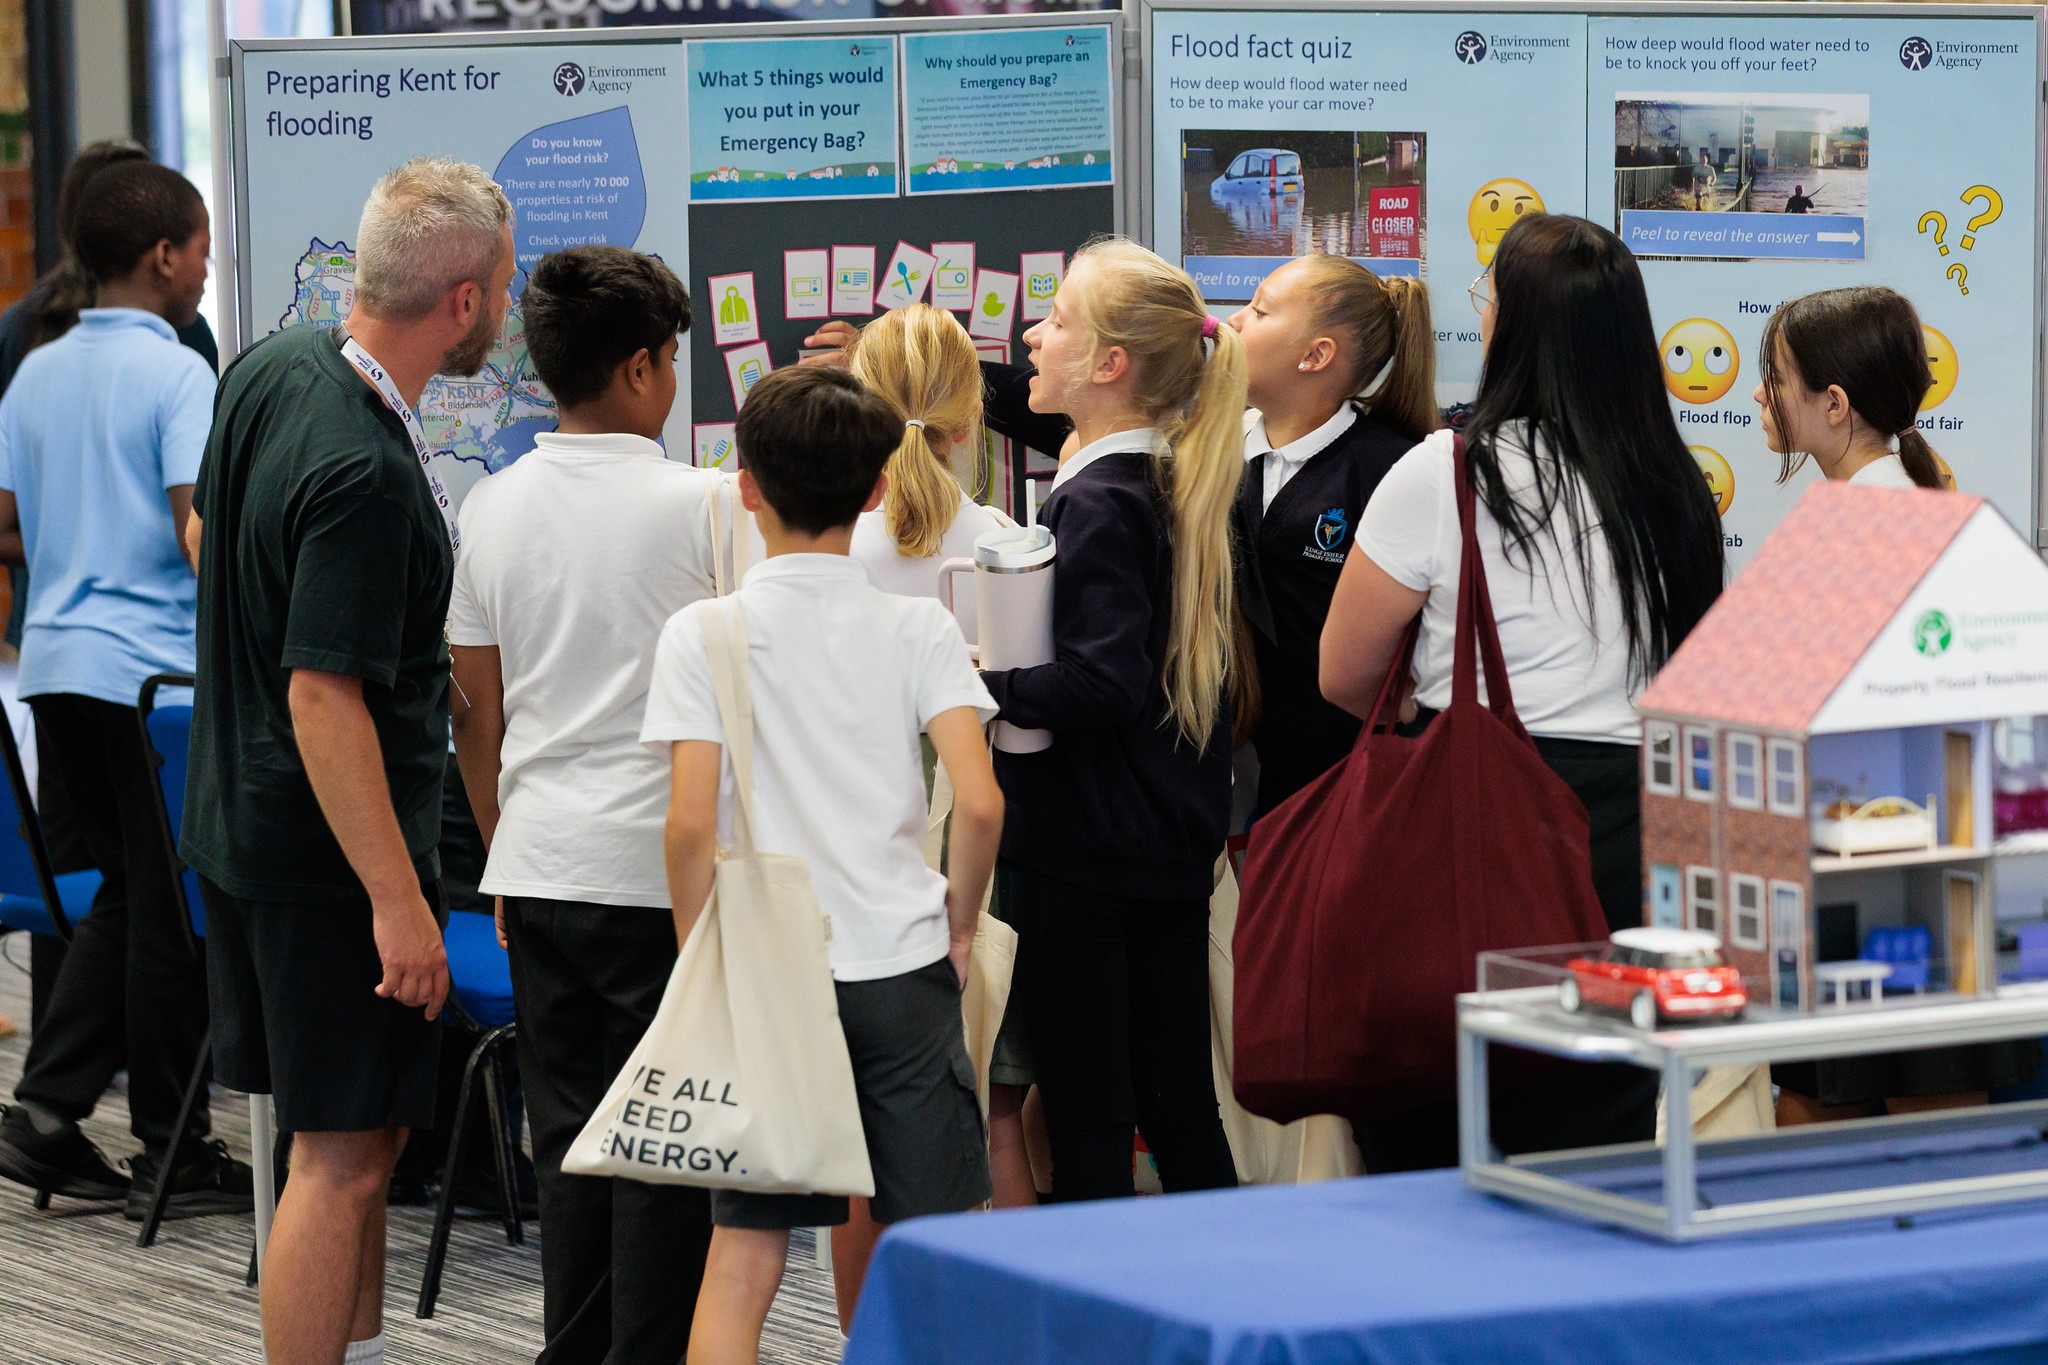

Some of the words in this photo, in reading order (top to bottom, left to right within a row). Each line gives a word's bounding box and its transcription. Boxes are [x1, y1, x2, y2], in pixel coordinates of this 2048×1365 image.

[1171, 34, 1239, 58] Flood
[1247, 34, 1294, 58] fact
[1301, 36, 1353, 64] quiz
[1490, 35, 1571, 48] Environment
[1604, 36, 1638, 51] How
[1641, 37, 1675, 54] deep
[1679, 37, 1724, 52] would
[1728, 38, 1765, 52] flood
[1770, 39, 1810, 53] water
[1815, 39, 1851, 53] need
[1854, 40, 1870, 53] to
[1935, 41, 2019, 54] Environment
[925, 57, 952, 70] Why
[956, 54, 997, 68] should
[1000, 54, 1023, 67] you
[1025, 52, 1073, 66] prepare
[1075, 51, 1090, 62] an
[1490, 49, 1535, 64] Agency
[1935, 54, 1982, 70] Agency
[588, 65, 666, 77] Environment
[1605, 57, 1623, 70] be
[1626, 58, 1642, 70] to
[1645, 57, 1687, 71] knock
[1690, 60, 1717, 75] you
[1720, 57, 1742, 71] off
[1744, 61, 1776, 76] your
[1779, 57, 1818, 72] feet?
[267, 69, 391, 100] Preparing
[400, 67, 457, 92] Kent
[464, 65, 501, 90] for
[698, 71, 748, 87] What
[754, 70, 764, 86] 5
[769, 69, 824, 88] things
[829, 66, 884, 84] would
[960, 75, 1026, 90] Emergency
[1029, 73, 1058, 87] Bag?
[1170, 76, 1202, 91] How
[1205, 76, 1240, 93] deep
[1243, 76, 1286, 91] would
[1289, 76, 1325, 92] flood
[1329, 78, 1370, 92] water
[1373, 77, 1408, 92] need
[588, 80, 632, 94] Agency
[1170, 97, 1184, 109] to
[1188, 96, 1206, 110] be
[1209, 97, 1224, 110] to
[1227, 96, 1265, 110] make
[1268, 98, 1299, 112] your
[1302, 99, 1325, 110] car
[1328, 97, 1375, 111] move?
[724, 106, 757, 123] you
[763, 103, 793, 121] put
[799, 101, 814, 117] in
[820, 103, 861, 120] your
[266, 109, 373, 140] flooding
[532, 138, 547, 149] Do
[550, 139, 570, 150] you
[572, 137, 603, 148] know
[720, 135, 818, 154] Emergency
[824, 131, 866, 151] Bag?
[525, 156, 551, 167] your
[553, 153, 581, 165] flood
[583, 152, 609, 164] risk?
[506, 179, 535, 190] There
[538, 180, 555, 189] are
[558, 177, 591, 190] nearly
[593, 176, 607, 187] 70
[609, 175, 630, 187] 000
[516, 195, 571, 208] properties
[573, 195, 584, 204] at
[586, 193, 605, 204] risk
[607, 192, 619, 203] of
[1379, 197, 1409, 210] ROAD
[527, 211, 570, 223] flooding
[572, 211, 582, 220] in
[585, 209, 609, 221] Kent
[529, 235, 560, 246] Check
[562, 235, 587, 247] your
[589, 233, 607, 244] risk
[1631, 225, 1661, 241] Peel
[1664, 228, 1679, 242] to
[1682, 226, 1727, 243] reveal
[1730, 228, 1753, 243] the
[1756, 231, 1809, 244] answer
[1194, 271, 1224, 286] Peel
[1226, 272, 1241, 286] to
[323, 292, 339, 300] M20
[1738, 301, 1772, 314] How
[1456, 331, 1483, 342] wou
[447, 385, 487, 399] KENT
[526, 383, 539, 394] A20
[448, 400, 488, 409] Biddenden
[1679, 410, 1719, 425] Flood
[1723, 411, 1752, 427] flop
[1915, 416, 1935, 430] od
[1939, 416, 1964, 431] fair
[672, 1077, 738, 1107] ALL
